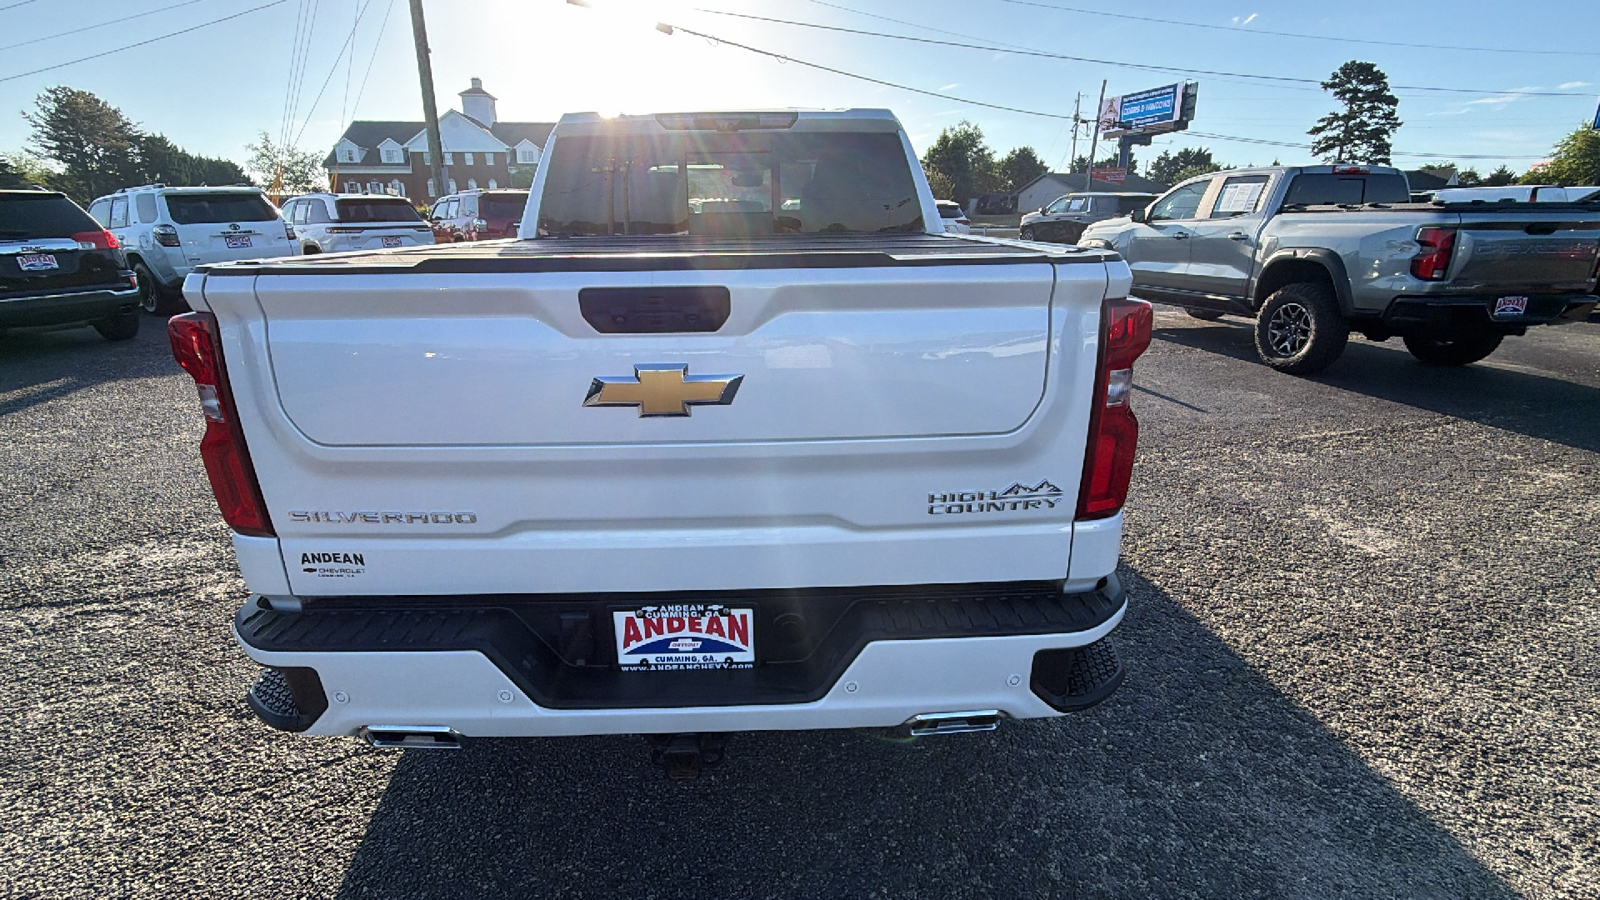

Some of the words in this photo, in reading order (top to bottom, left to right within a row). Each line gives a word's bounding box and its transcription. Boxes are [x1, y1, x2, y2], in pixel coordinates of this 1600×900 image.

[927, 490, 998, 503] HIGH
[927, 498, 1062, 514] COUNTRY
[288, 510, 477, 524] SILVERADO
[301, 552, 365, 566] ANDEAN
[645, 610, 702, 618] CUMMING,
[705, 610, 720, 618] GA
[660, 604, 705, 612] ANDEAN
[623, 613, 749, 650] ANDEAN
[655, 655, 700, 663] CUMMING,
